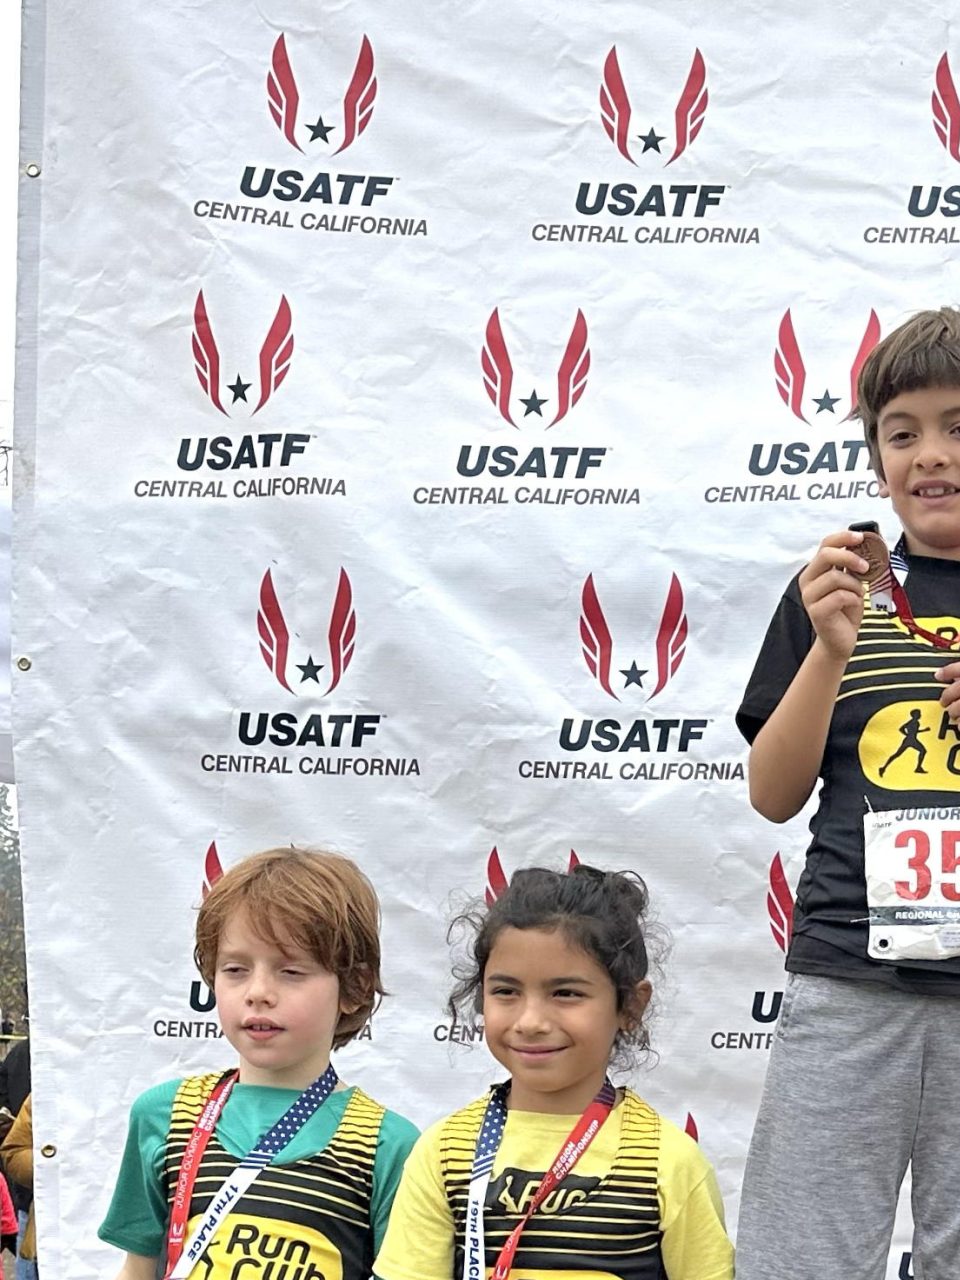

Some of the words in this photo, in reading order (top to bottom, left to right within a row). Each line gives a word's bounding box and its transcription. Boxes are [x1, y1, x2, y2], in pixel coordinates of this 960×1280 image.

[240, 166, 393, 206] USATF
[576, 183, 725, 217] USATF
[194, 201, 293, 228] CENTRAL
[301, 213, 427, 235] CALIFORNIA
[532, 224, 628, 243] CENTRAL
[635, 227, 759, 243] CALIFORNIA
[864, 227, 960, 244] CENTRAL
[177, 434, 310, 471] USATF
[457, 445, 606, 478] USATF
[748, 440, 874, 476] USAT
[135, 481, 227, 497] CENTRAL
[234, 477, 345, 498] CALIFORNIA
[413, 487, 508, 504] CENTRAL
[515, 487, 639, 505] CALIFORNIA
[704, 485, 801, 504] CENTRAL
[807, 481, 880, 500] CALIFO
[239, 713, 380, 747] USATF
[559, 719, 708, 752] USATF
[201, 755, 292, 773] CENTRAL
[299, 757, 420, 775] CALIFORNIA
[519, 761, 612, 779] CENTRAL
[620, 763, 744, 780] CALIFORNIA
[897, 808, 960, 822] JUNIOR
[895, 911, 944, 920] REGIONAL
[552, 1140, 575, 1174] REGION
[555, 1119, 600, 1180] CHAMPIONSHIP
[177, 1172, 189, 1209] JUNIOR
[183, 1131, 202, 1170] OLYMPIC
[214, 1184, 239, 1216] 17TH
[470, 1199, 480, 1233] 19TH
[187, 1213, 218, 1262] PLACE
[226, 1223, 312, 1262] Run
